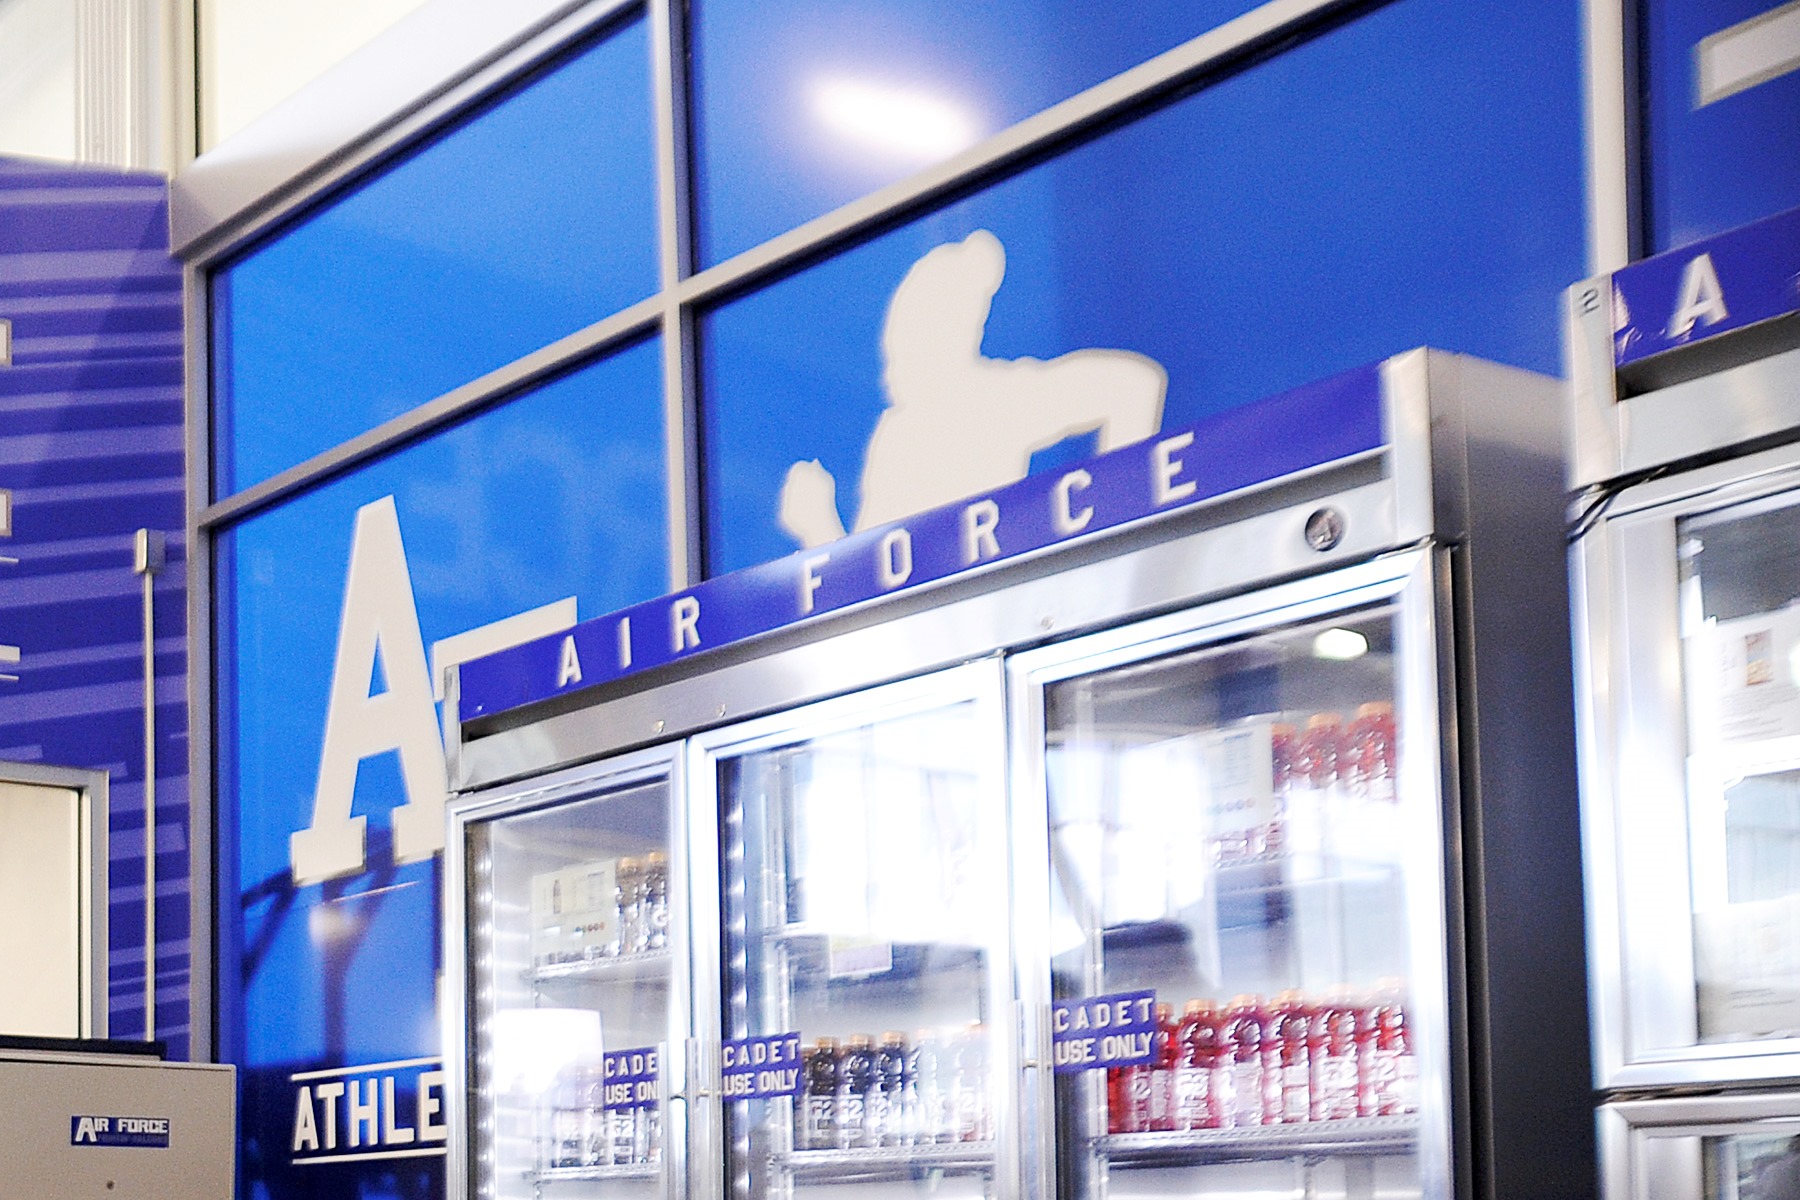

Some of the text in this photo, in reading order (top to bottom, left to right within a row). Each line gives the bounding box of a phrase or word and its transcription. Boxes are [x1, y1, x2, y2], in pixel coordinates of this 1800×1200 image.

[556, 430, 1197, 690] AIR FORCE
[1053, 997, 1153, 1033] CADET
[723, 1038, 799, 1067] CADET
[1055, 1030, 1154, 1066] USE ONLY
[605, 1081, 633, 1105] USE
[724, 1068, 799, 1096] USE ONLY
[75, 1117, 110, 1142] AIR
[119, 1118, 168, 1133] FORCE
